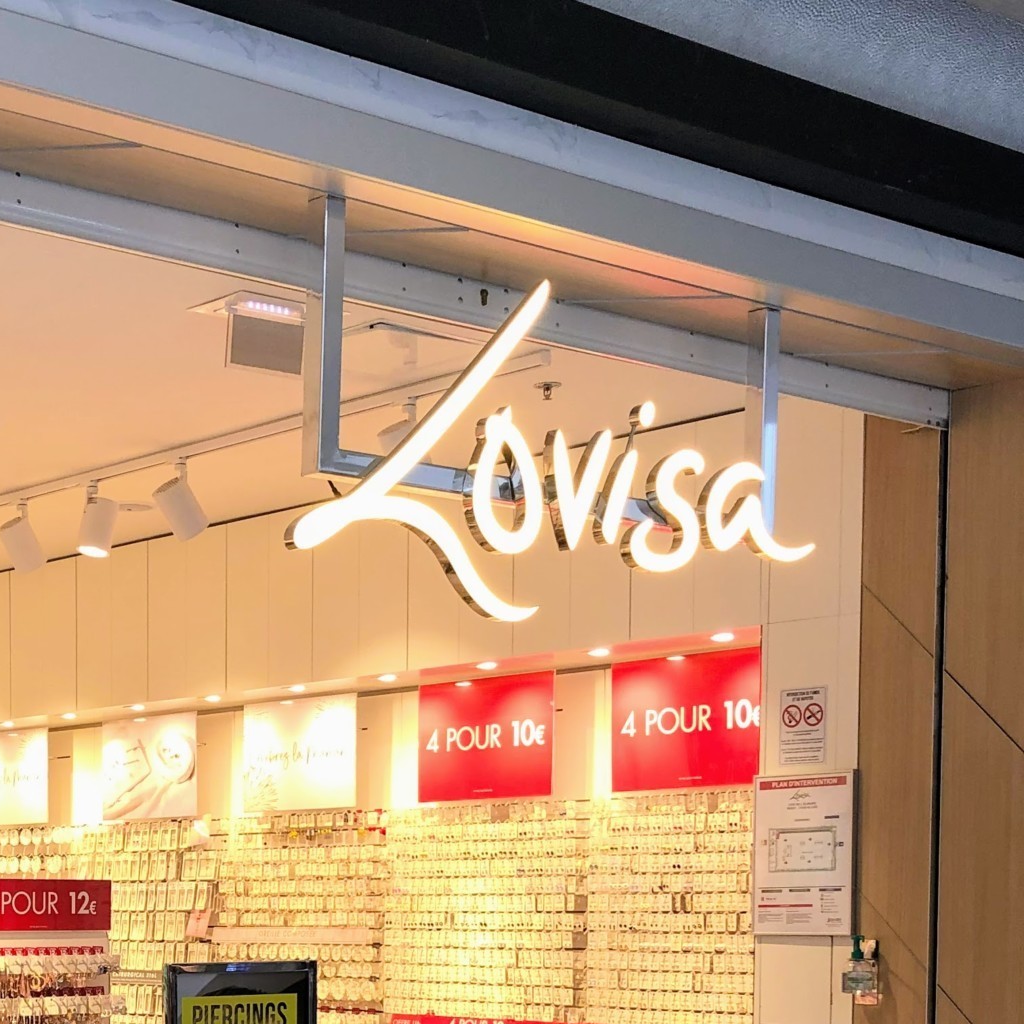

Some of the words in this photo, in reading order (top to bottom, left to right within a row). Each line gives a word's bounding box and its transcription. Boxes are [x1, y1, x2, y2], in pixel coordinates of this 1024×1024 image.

[287, 279, 816, 622] Lovisa
[425, 728, 440, 754] 4
[446, 724, 502, 752] POUR
[511, 719, 546, 747] 10€
[620, 710, 637, 738] 4
[645, 704, 712, 736] POUR
[1, 891, 59, 915] POUR
[69, 891, 97, 915] 12€
